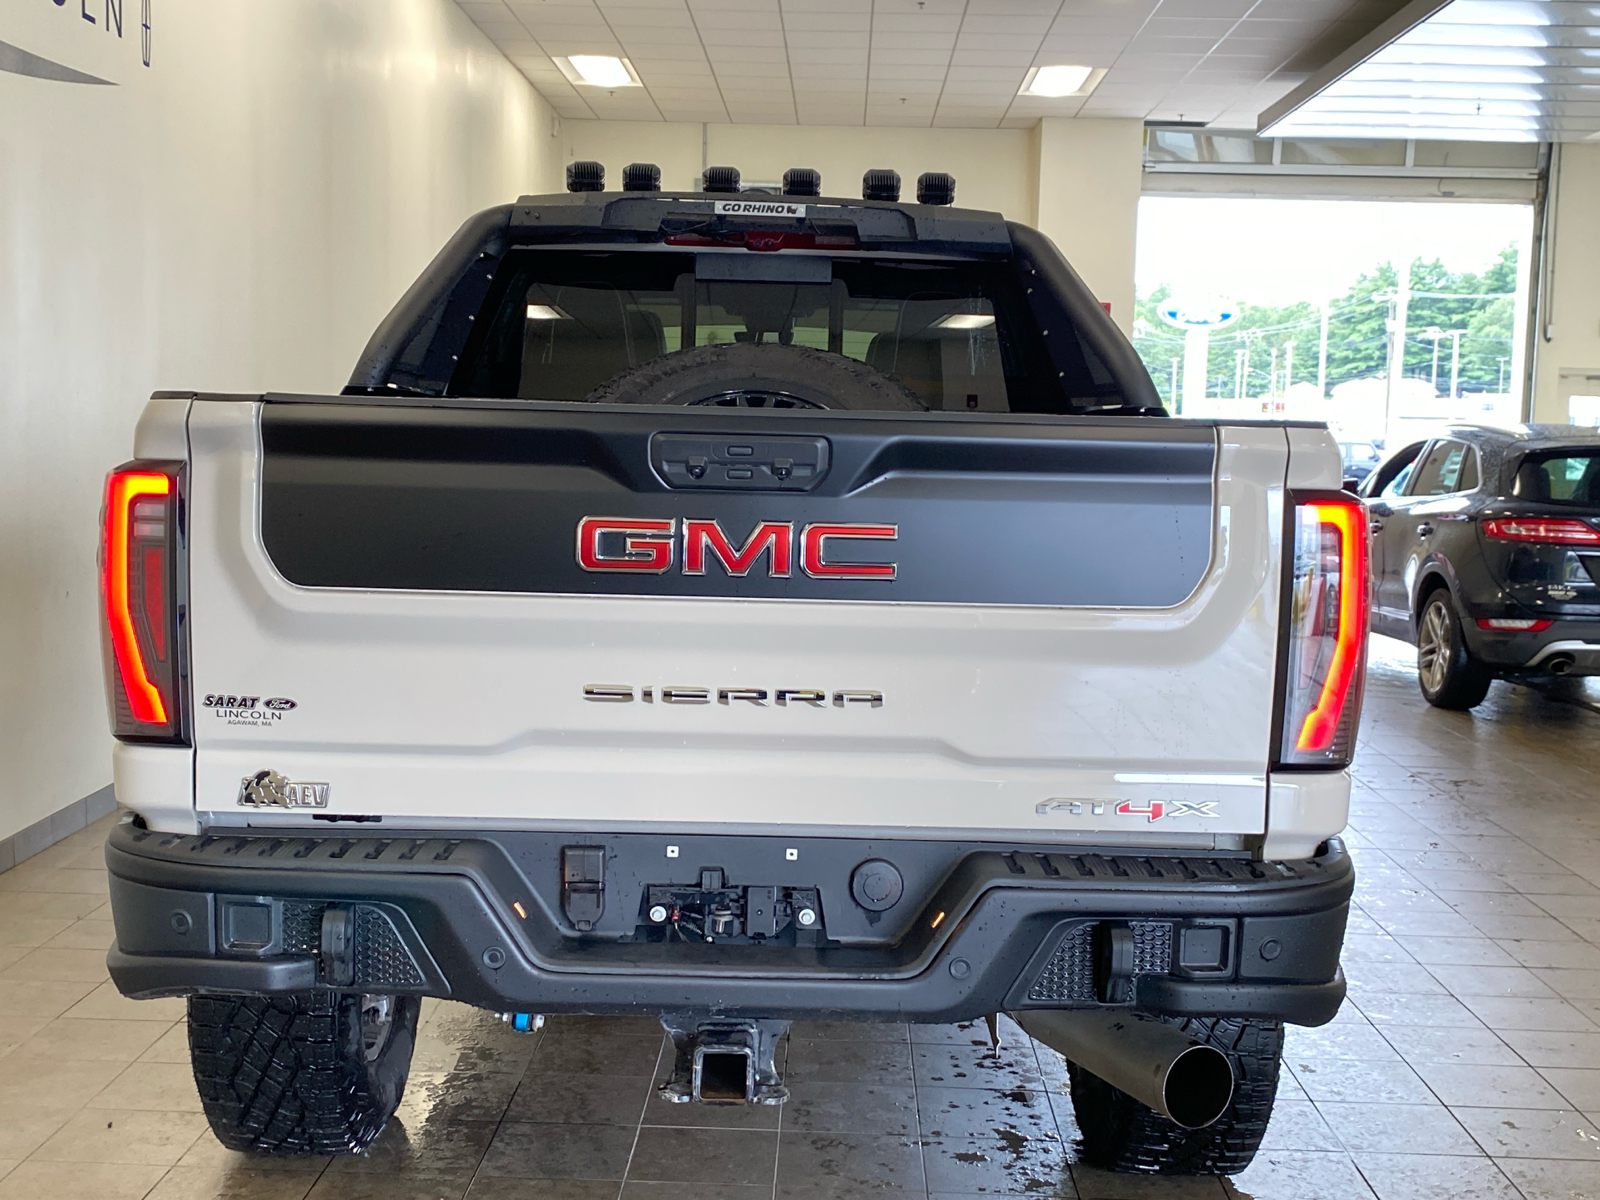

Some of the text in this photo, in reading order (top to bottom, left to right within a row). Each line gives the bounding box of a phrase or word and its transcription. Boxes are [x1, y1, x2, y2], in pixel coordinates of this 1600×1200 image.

[722, 203, 785, 214] GO RHINO
[576, 515, 898, 581] GMC
[203, 694, 259, 709] SARAT
[582, 684, 884, 708] SIERRA
[216, 709, 282, 720] LINCOLN
[227, 719, 260, 727] AGAWAM,
[288, 783, 327, 806] AEV
[1036, 797, 1221, 823] AT4X
